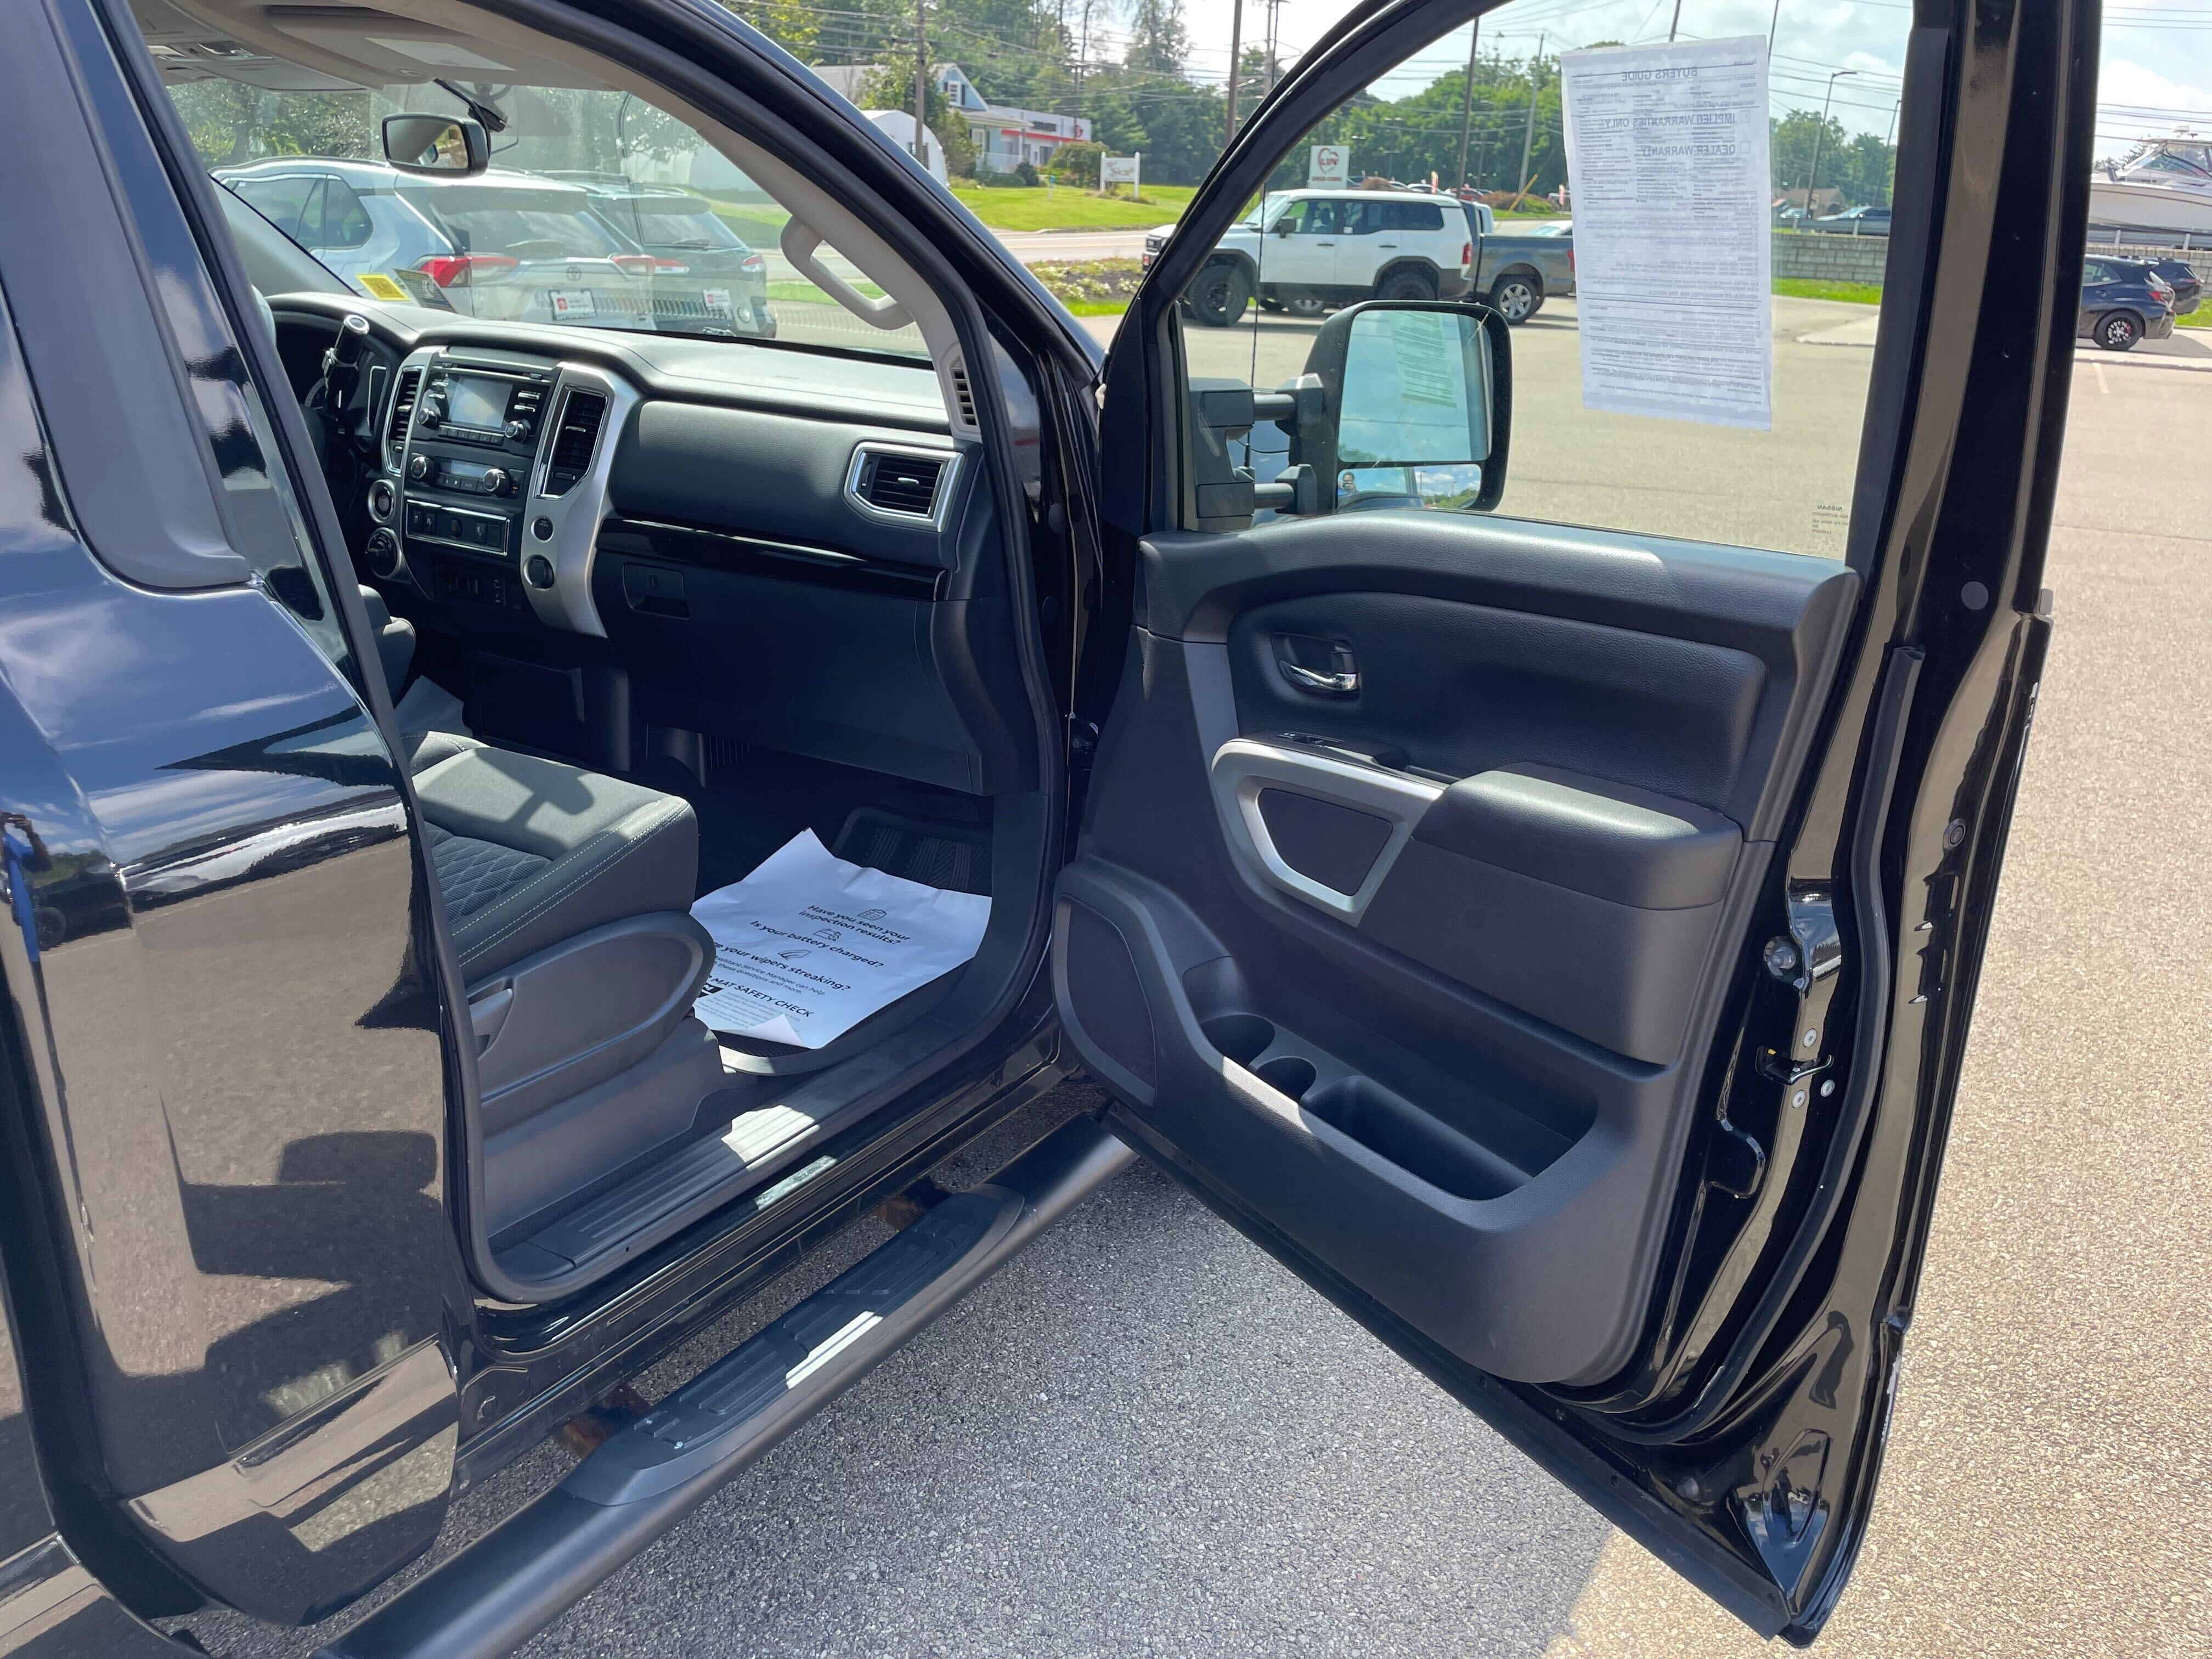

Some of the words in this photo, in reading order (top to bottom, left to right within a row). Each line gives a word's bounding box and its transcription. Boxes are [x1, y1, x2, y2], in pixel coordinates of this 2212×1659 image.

[798, 910, 855, 929] inspection
[855, 928, 901, 945] results?
[808, 905, 835, 915] Have
[833, 913, 857, 922] you
[856, 921, 883, 932] seen
[882, 929, 911, 940] your
[759, 926, 788, 936] your
[787, 933, 830, 948] battery
[830, 946, 884, 967] charged?
[721, 946, 751, 957] your
[751, 955, 788, 969] wipers
[788, 967, 851, 991] streaking?
[710, 978, 737, 987] MAT
[735, 985, 777, 1002] SAFETY
[775, 1000, 815, 1017] CHECK
